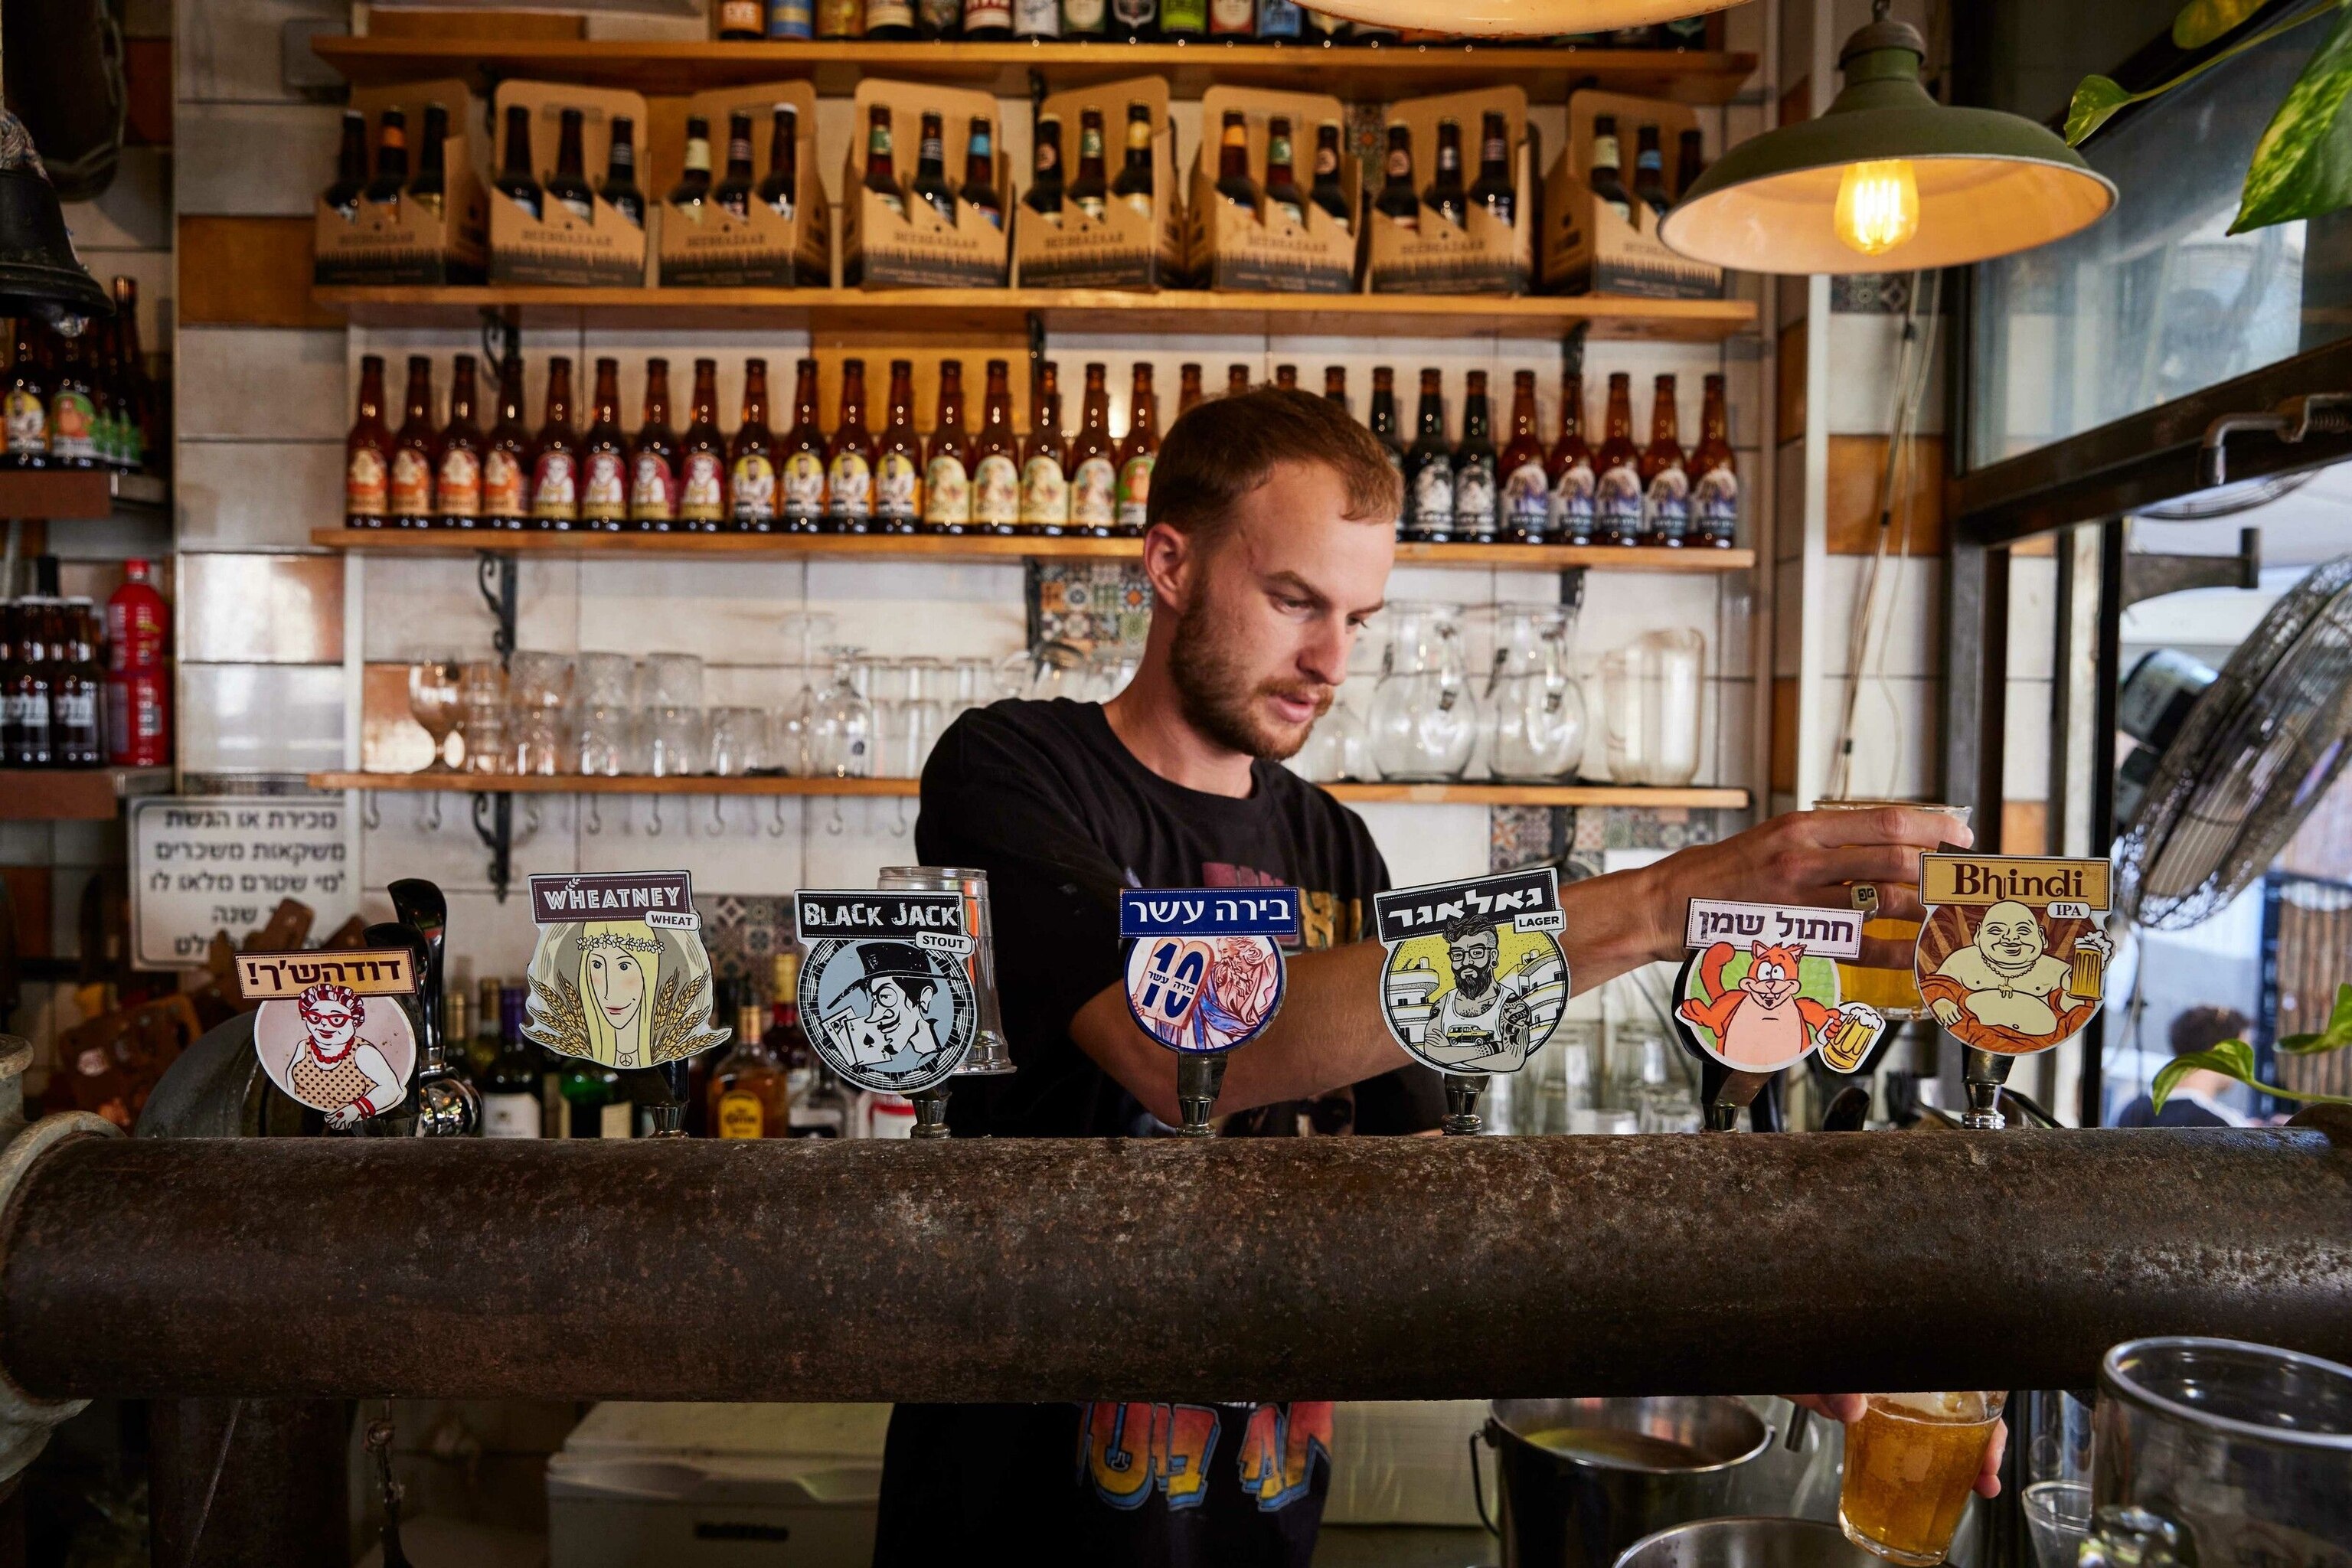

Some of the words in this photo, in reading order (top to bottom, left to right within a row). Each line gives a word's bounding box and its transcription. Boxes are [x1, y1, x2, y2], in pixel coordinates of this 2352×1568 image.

[165, 810, 230, 828] הגשת
[237, 810, 260, 828] או
[268, 811, 337, 829] מכירת
[155, 842, 245, 861] משכרים
[253, 842, 346, 867] משקאות
[149, 871, 171, 892] לו
[178, 871, 234, 891] מלאו
[240, 874, 308, 892] שטרם
[1951, 863, 2089, 900] Bhindi
[544, 887, 681, 910] WHEATNEY
[1388, 887, 1543, 928] גאלאגר
[211, 905, 259, 923] שנה
[804, 903, 884, 926] BLACK
[891, 902, 959, 926] JACK
[1129, 900, 1204, 924] עשר
[1216, 899, 1291, 921] בירה
[2056, 905, 2082, 916] IPA
[652, 914, 692, 926] WHEAT
[1519, 916, 1560, 927] LAGER
[1698, 910, 1766, 939] שמן
[1776, 910, 1853, 942] חתול
[923, 936, 965, 949] STOUT
[1142, 942, 1204, 1018] 10
[1148, 971, 1169, 984] עשר
[1173, 981, 1195, 995] בירה
[1511, 1010, 1528, 1022] אמא
